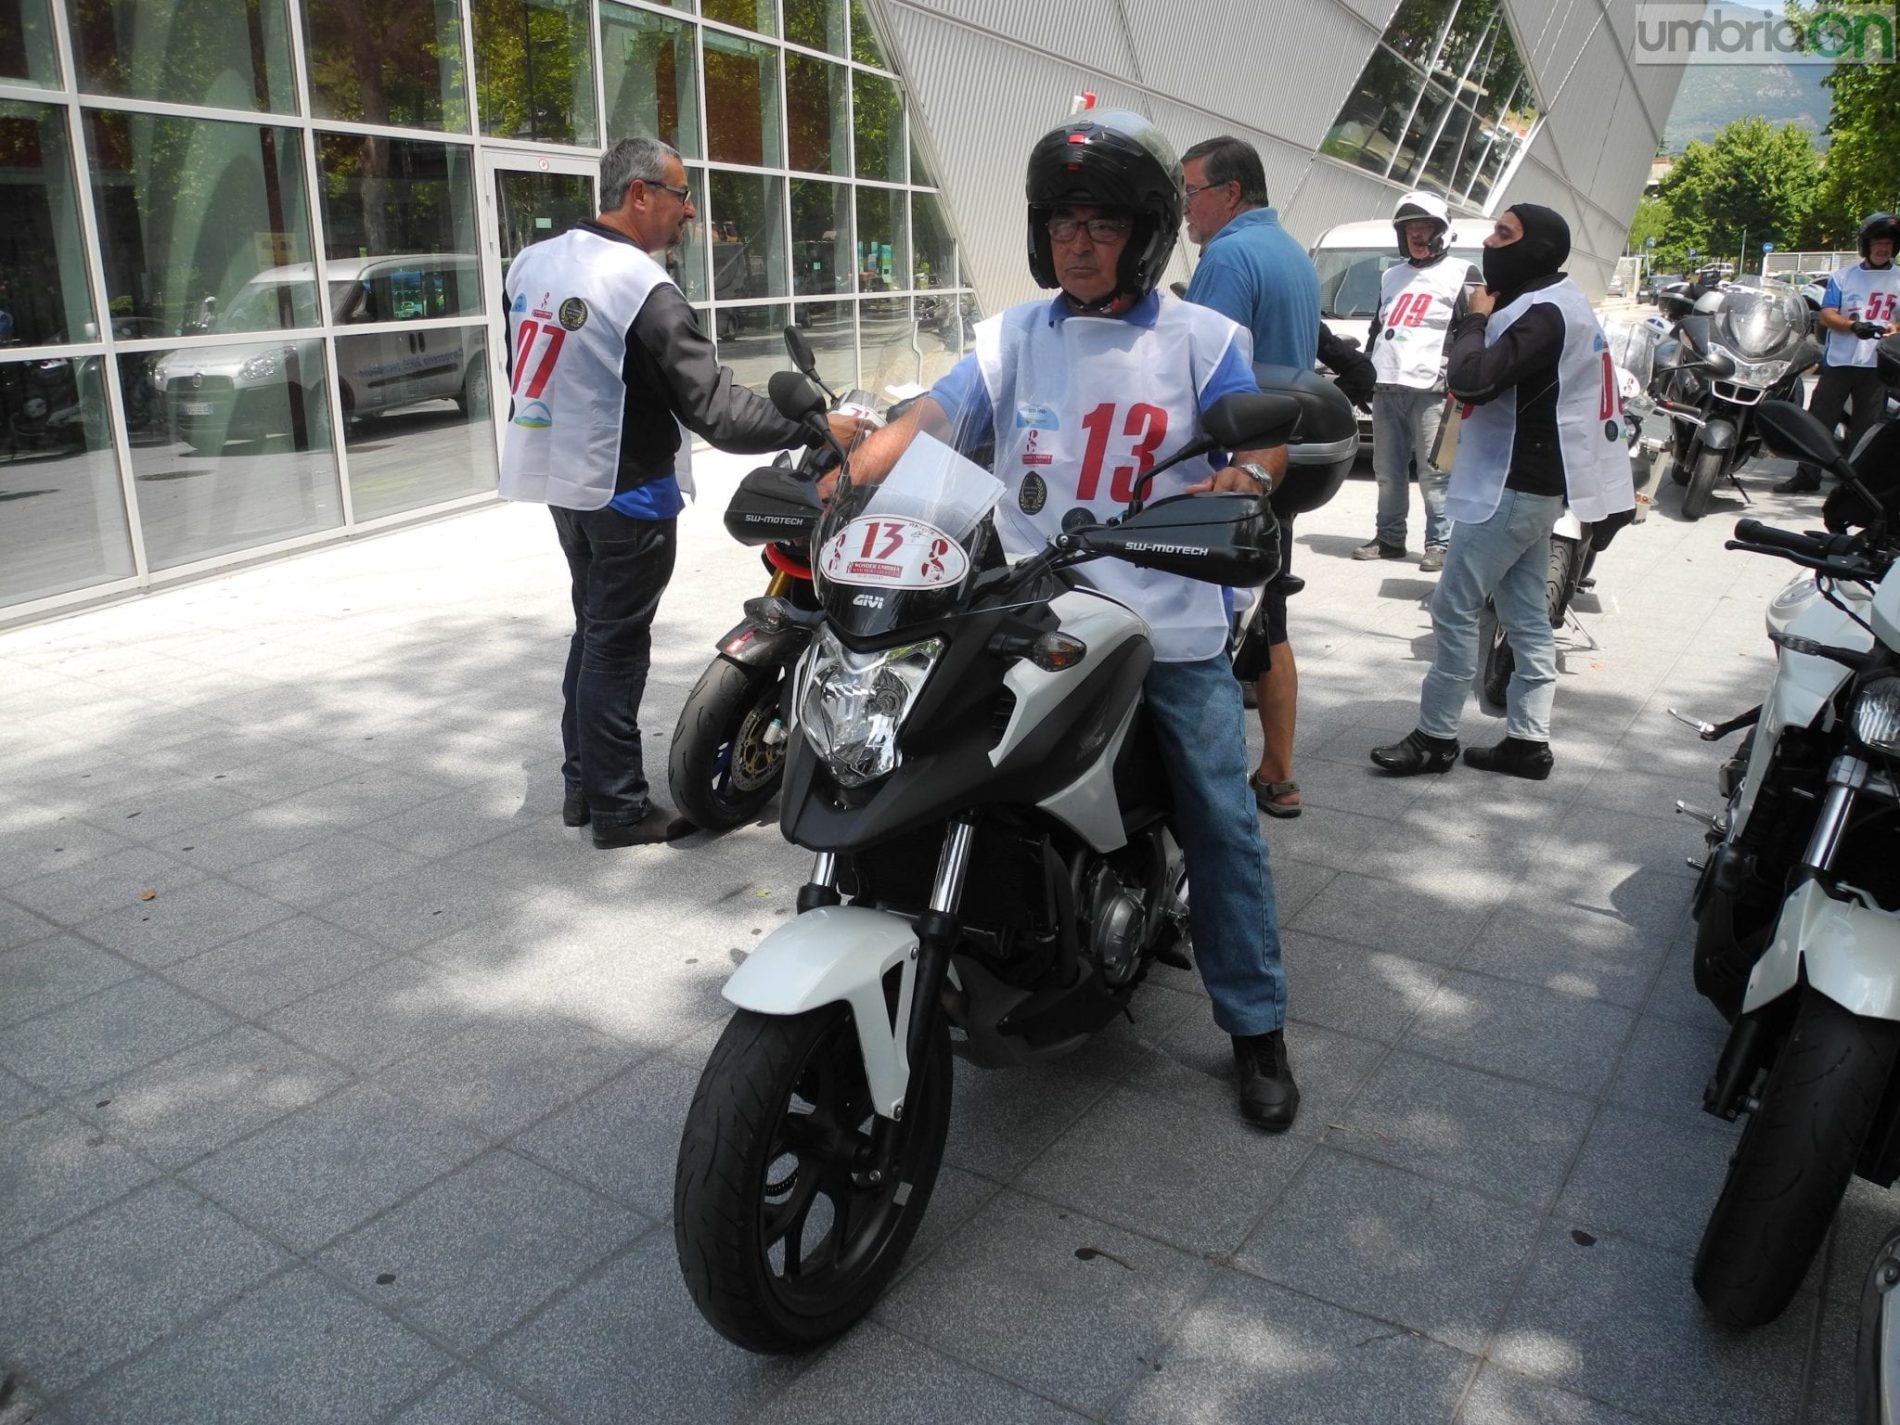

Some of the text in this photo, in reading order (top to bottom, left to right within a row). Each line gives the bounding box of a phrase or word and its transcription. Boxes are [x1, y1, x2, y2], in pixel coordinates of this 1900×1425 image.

[1388, 293, 1433, 327] 09
[1865, 292, 1897, 321] 55
[512, 320, 566, 399] 07
[1076, 402, 1168, 504] 13
[745, 514, 804, 526] SW-MOTECH
[861, 522, 905, 559] 13
[1124, 541, 1209, 557] SW-MOTECH
[853, 594, 884, 609] GIVI
